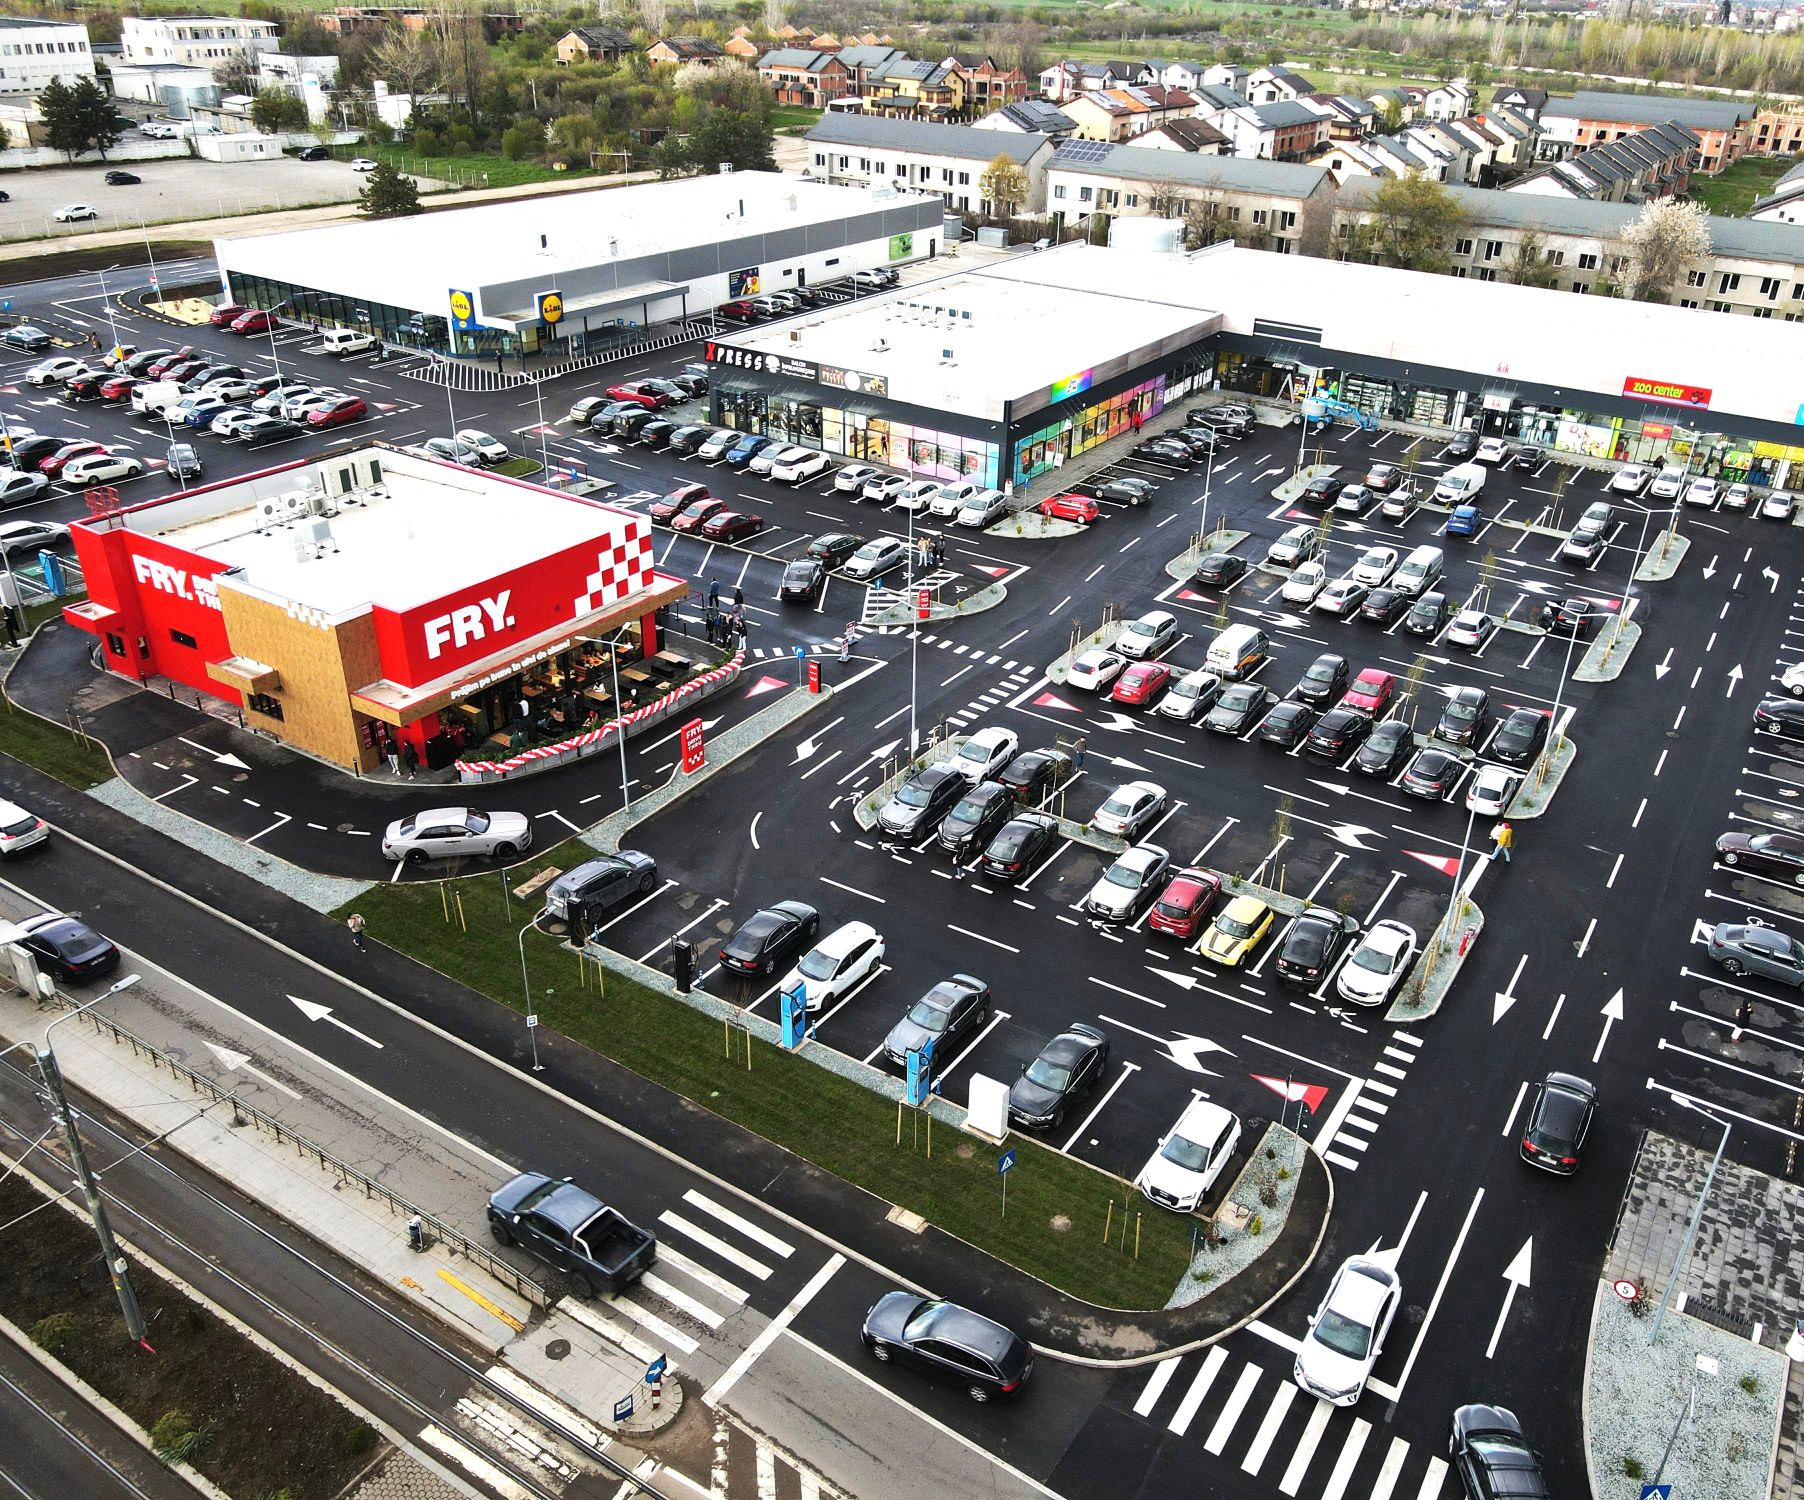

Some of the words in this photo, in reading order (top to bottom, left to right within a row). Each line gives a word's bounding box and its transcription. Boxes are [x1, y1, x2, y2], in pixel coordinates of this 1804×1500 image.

[544, 305, 562, 314] LIDL
[705, 342, 763, 371] XPRESS
[1633, 382, 1652, 394] zoo
[1653, 385, 1684, 399] center
[132, 554, 193, 601] FRY.
[424, 589, 515, 660] FRY.
[1623, 1286, 1629, 1294] 5
